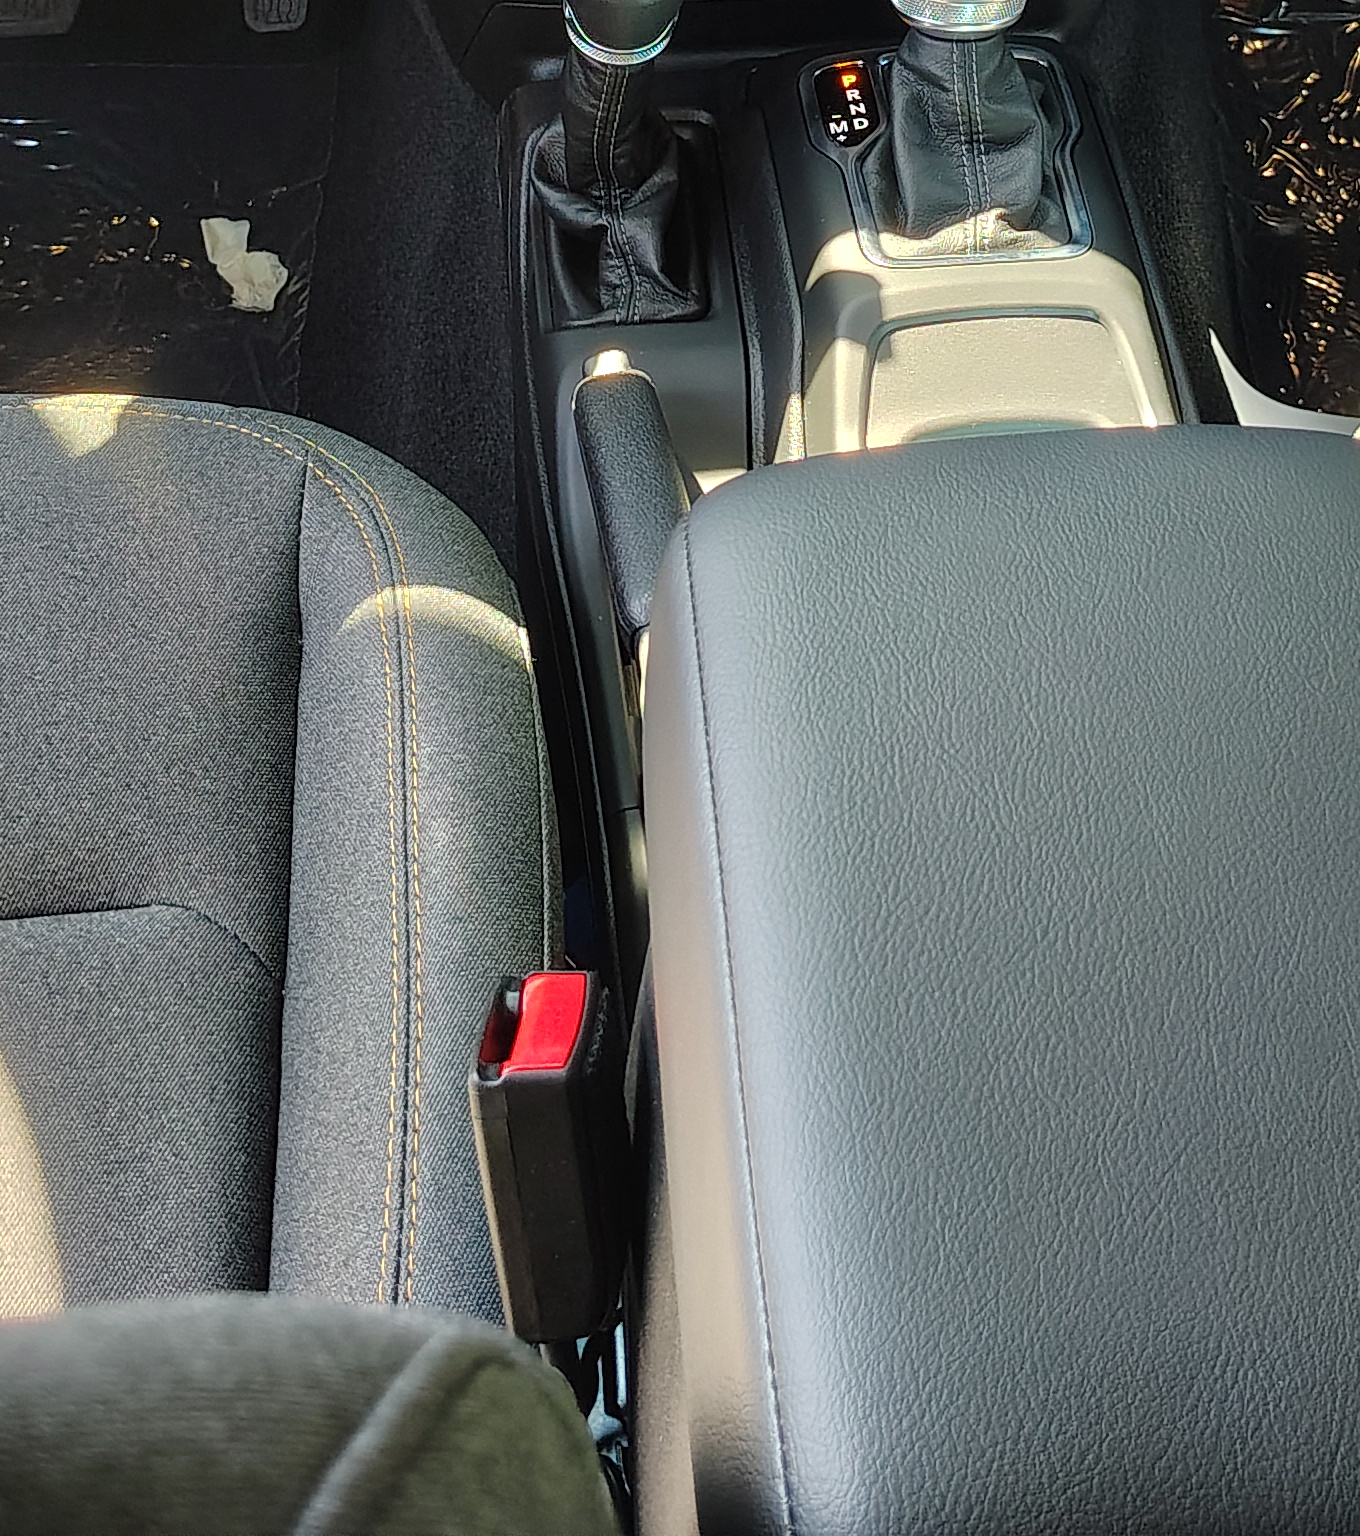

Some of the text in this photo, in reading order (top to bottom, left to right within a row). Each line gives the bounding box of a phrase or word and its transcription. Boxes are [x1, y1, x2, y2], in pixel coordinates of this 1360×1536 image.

[841, 74, 857, 88] P
[845, 89, 862, 101] R
[849, 103, 866, 115] N
[829, 118, 869, 134] M D
